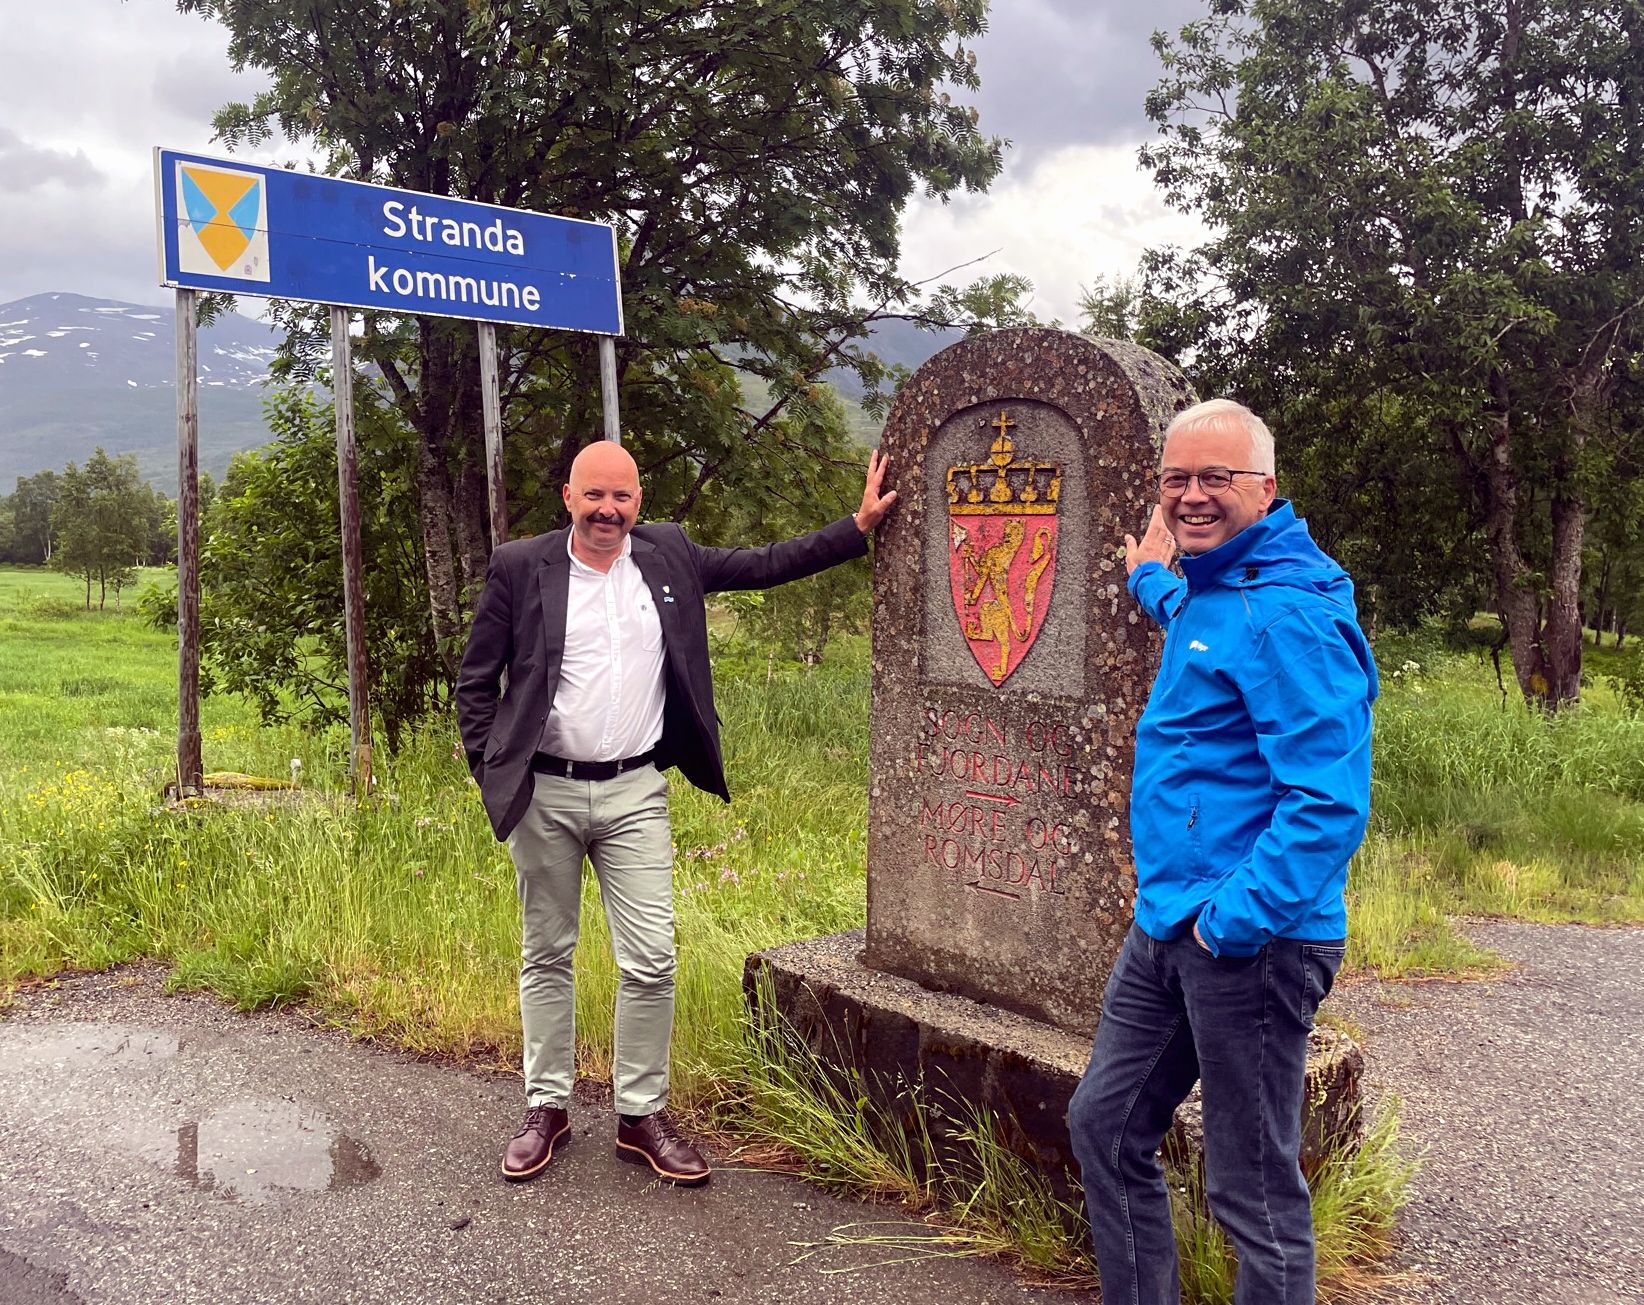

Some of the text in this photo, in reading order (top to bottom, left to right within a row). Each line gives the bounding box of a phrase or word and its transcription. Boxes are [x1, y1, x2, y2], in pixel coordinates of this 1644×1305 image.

[382, 200, 524, 256] Stranda
[367, 255, 541, 311] kommune
[923, 707, 1073, 757] SOGN OG
[916, 741, 1079, 800] FJORDANE
[920, 798, 1073, 857] MØRE OG
[923, 833, 1067, 896] ROMSDAL
